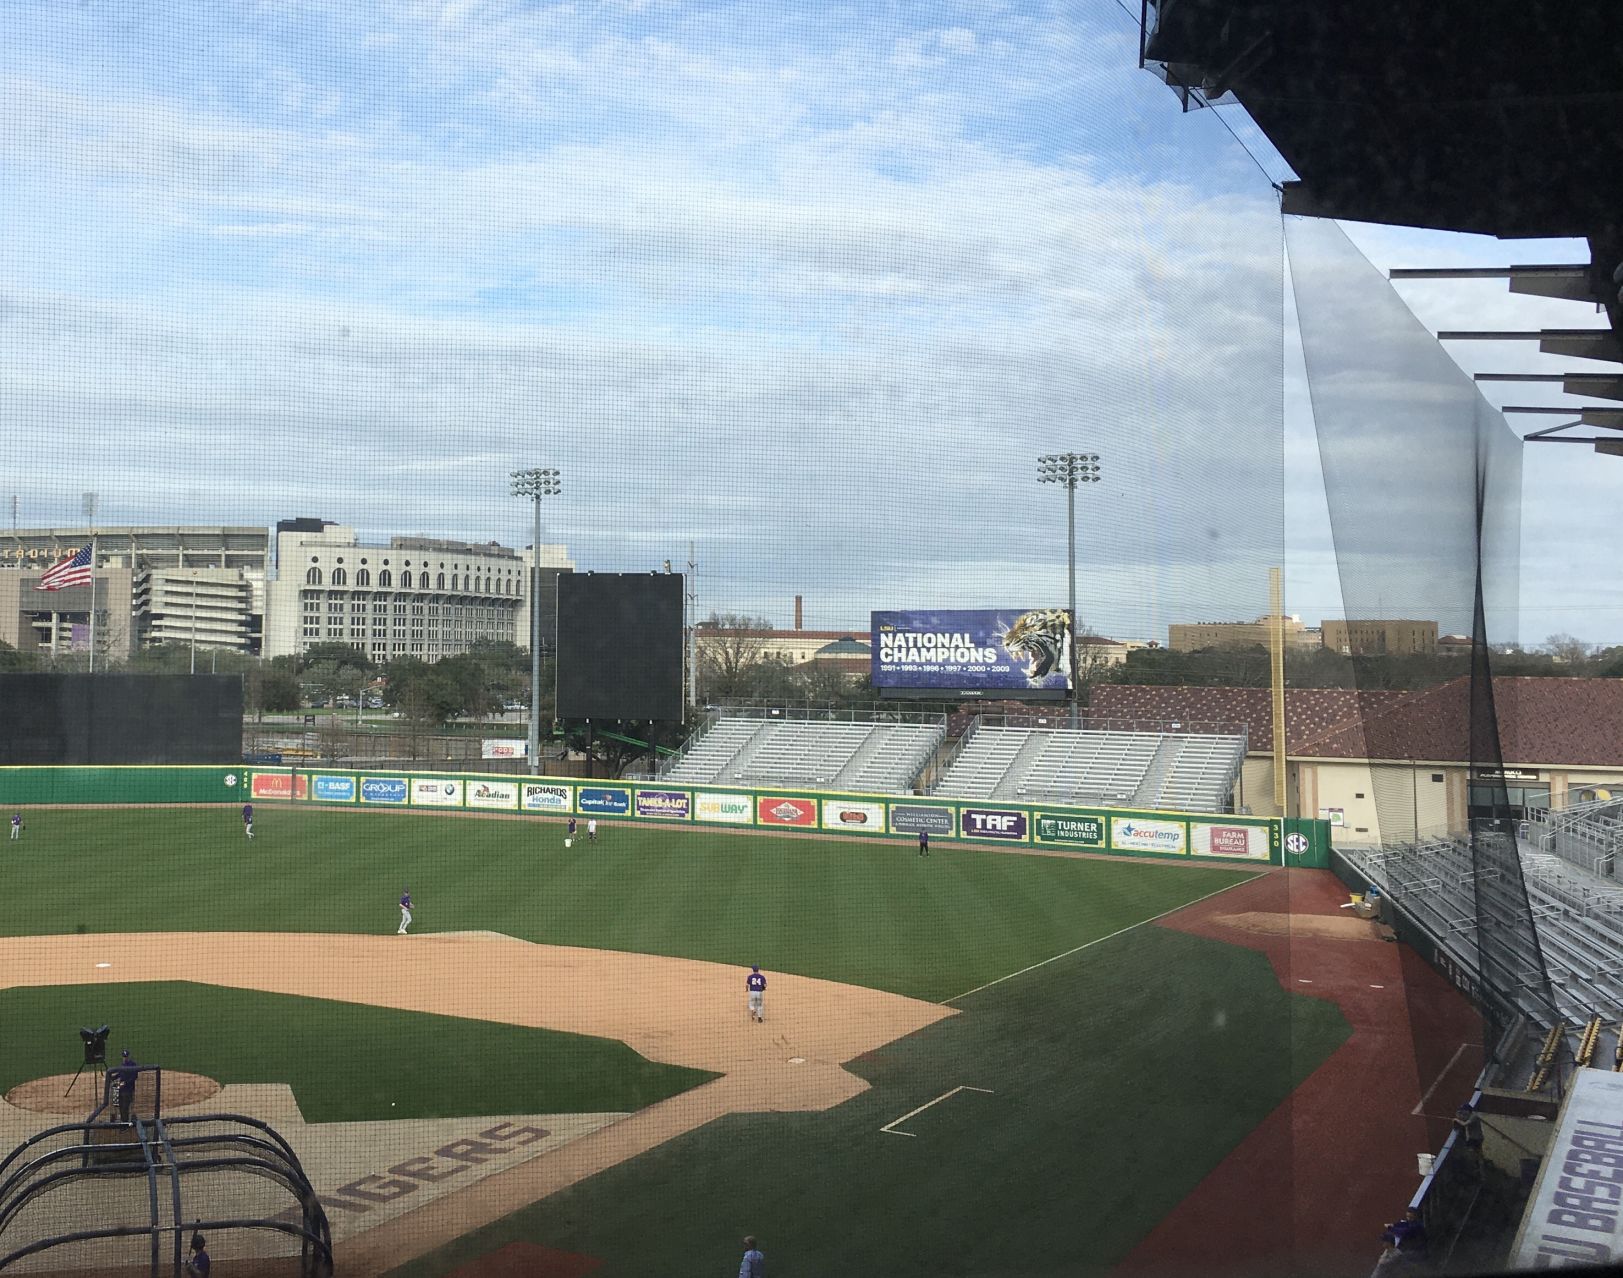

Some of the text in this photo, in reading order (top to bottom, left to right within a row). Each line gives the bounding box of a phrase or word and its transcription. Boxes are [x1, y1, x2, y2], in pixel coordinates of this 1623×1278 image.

[880, 633, 975, 647] NATIONAL
[879, 647, 998, 663] CHAMPIONS
[328, 782, 351, 790] BASF
[363, 782, 405, 792] GROUP
[259, 788, 301, 796] McDonalds
[474, 789, 510, 799] Acadian
[527, 786, 567, 799] RICHARDS
[532, 796, 562, 804] Honda
[700, 802, 746, 814] SUBWAY
[926, 817, 949, 825] CENTER
[971, 813, 1018, 830] TAF
[1057, 820, 1098, 832] TURNER
[1057, 830, 1098, 839] INDUSTRIES
[1132, 829, 1180, 841] accutemp
[1222, 831, 1245, 839] FARM
[1214, 837, 1245, 846] BUREAU
[1286, 833, 1307, 853] SEC
[751, 977, 762, 986] 24
